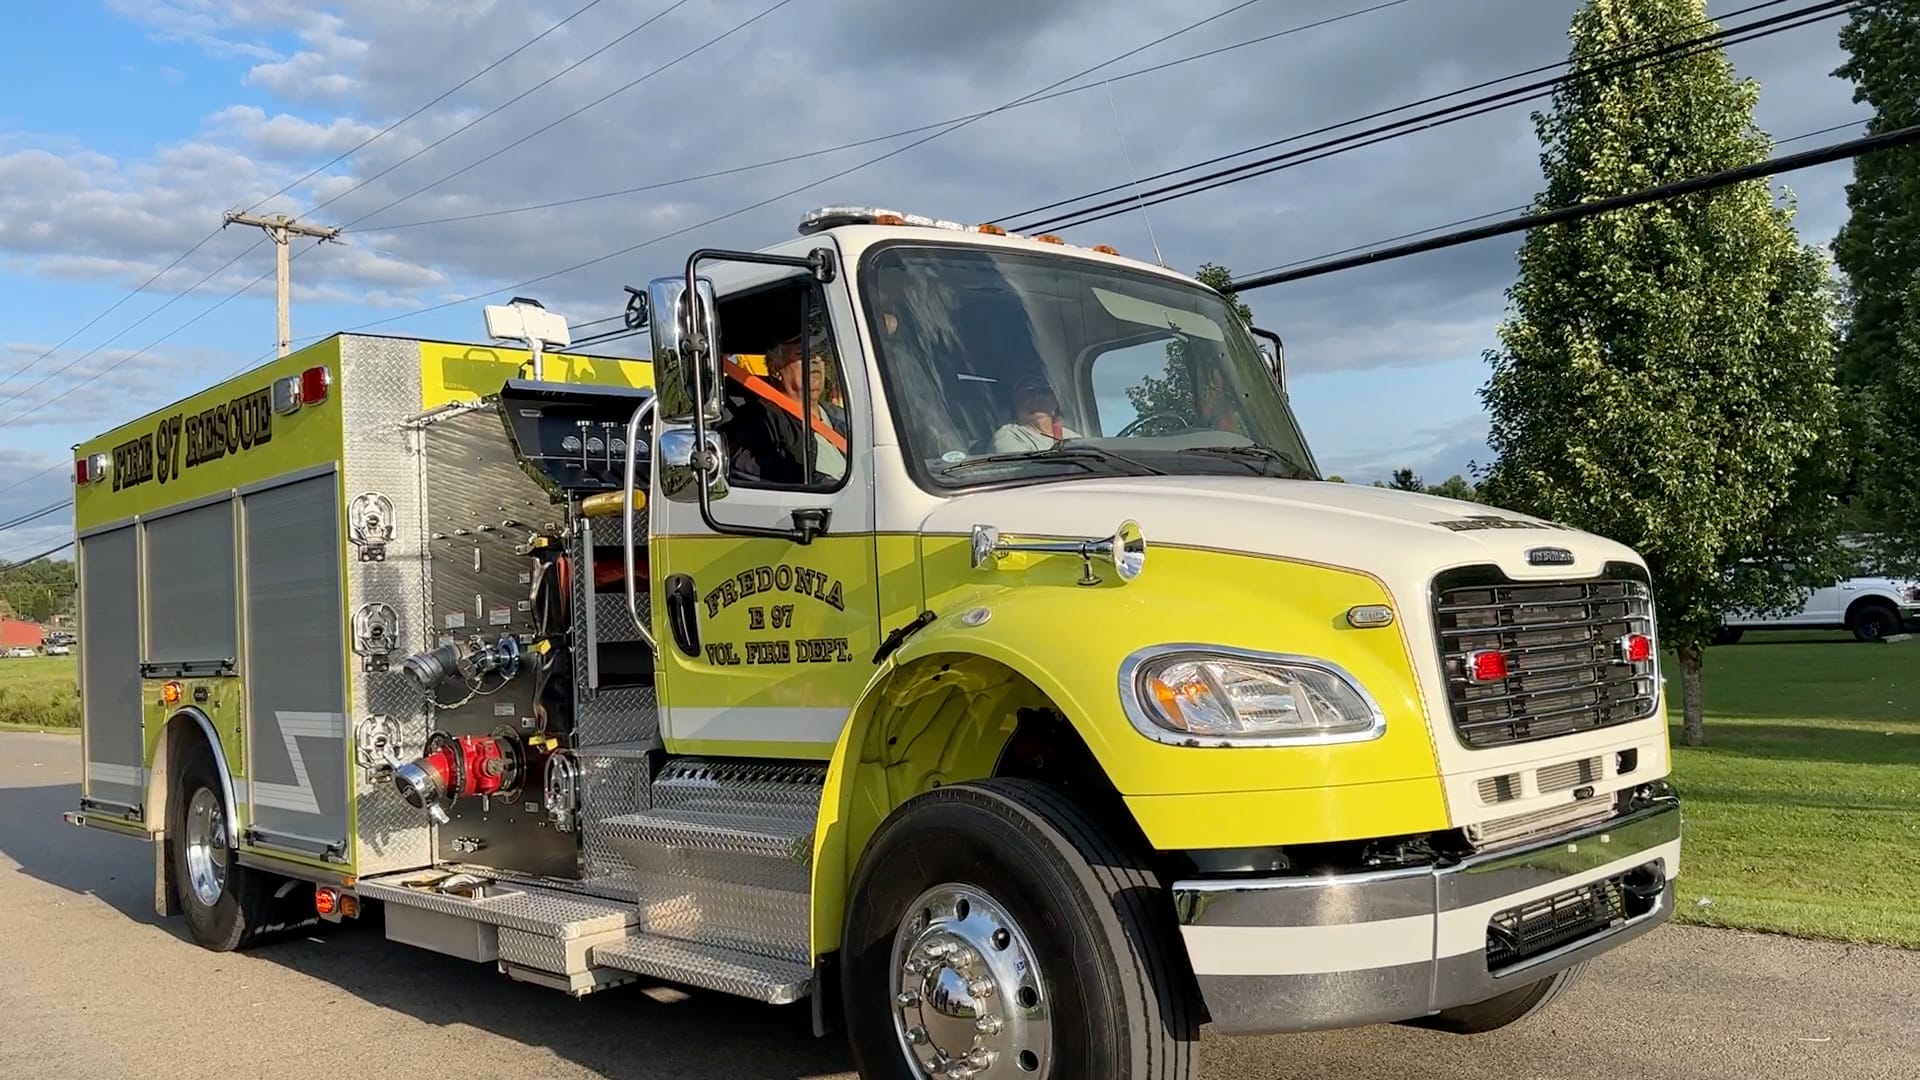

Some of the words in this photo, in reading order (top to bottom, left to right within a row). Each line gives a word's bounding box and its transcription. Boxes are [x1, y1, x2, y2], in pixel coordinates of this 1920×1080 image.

[112, 433, 153, 492] FIRE
[157, 414, 183, 484] 97
[185, 386, 272, 468] RESCUE
[704, 564, 845, 619] FREDONIA
[749, 607, 765, 629] E
[771, 604, 794, 629] 97
[705, 642, 741, 666] VOL
[745, 640, 790, 664] FIRE
[796, 638, 852, 664] DEPT.
